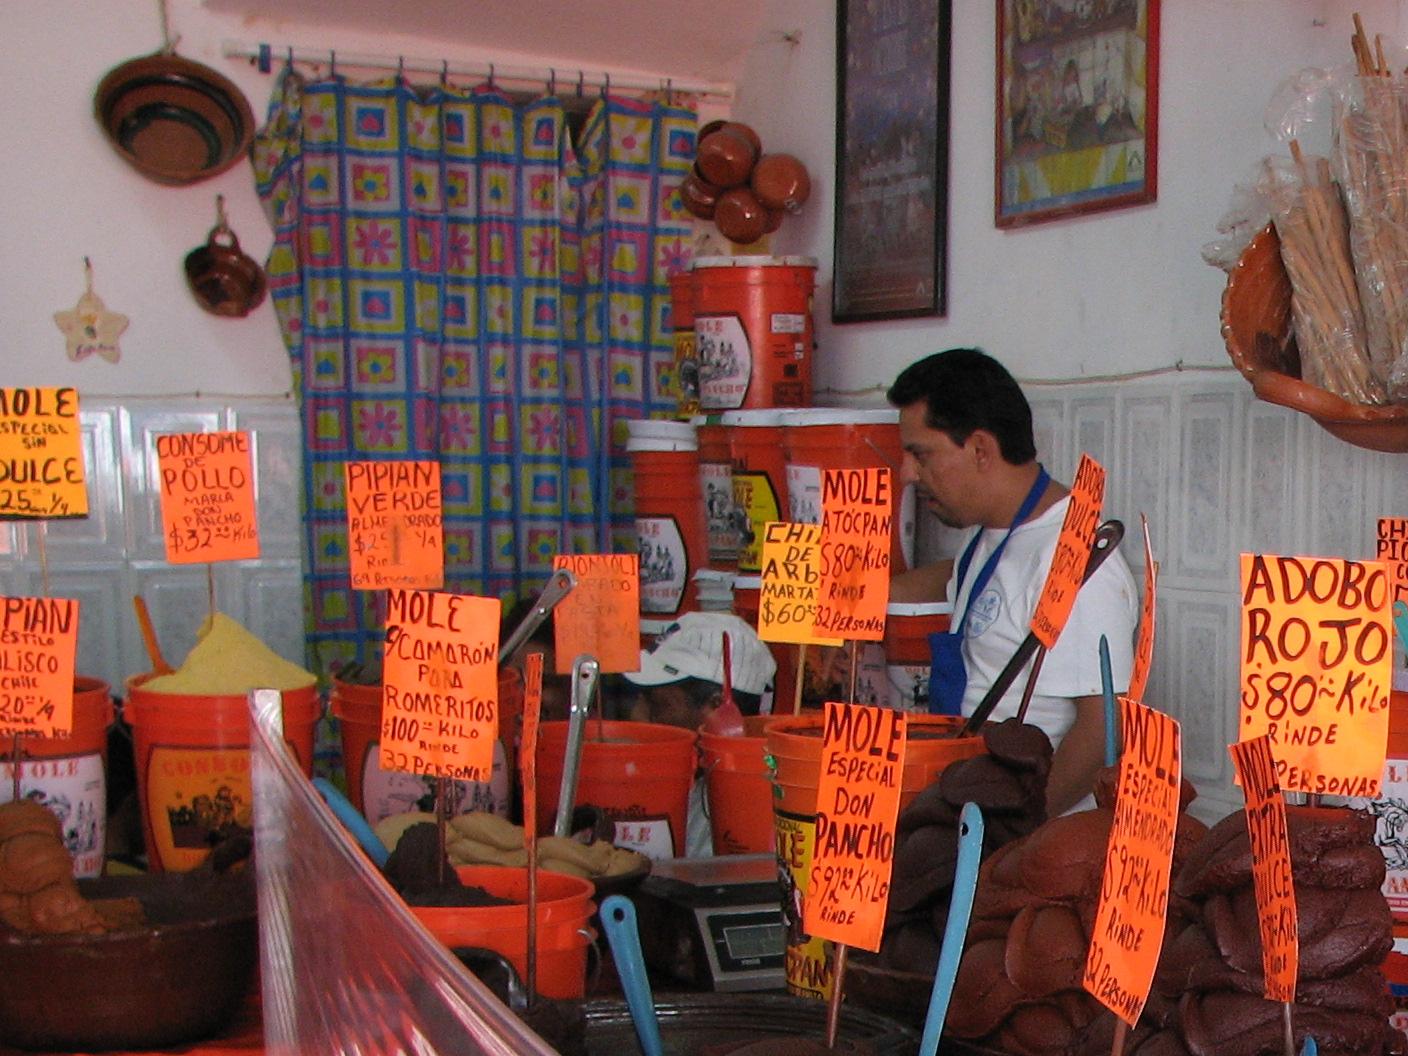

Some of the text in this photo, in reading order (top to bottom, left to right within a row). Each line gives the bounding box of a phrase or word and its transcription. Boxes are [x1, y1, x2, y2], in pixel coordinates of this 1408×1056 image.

[0, 421, 68, 435] SPECiAL
[157, 432, 248, 459] CONSOME
[184, 456, 206, 468] DE
[348, 461, 433, 493] PIPIAN
[163, 466, 245, 495] POLLO
[823, 469, 889, 506] MOLE
[352, 489, 441, 514] VERDE
[786, 546, 814, 562] DE
[1244, 554, 1388, 612] ADOBO
[387, 588, 464, 633] MOLE
[1246, 607, 1388, 670] ROJO
[0, 650, 58, 673] LiSCO
[418, 664, 464, 689] PARA
[385, 685, 495, 723] ROMERITOS
[438, 720, 479, 738] KILO
[824, 704, 904, 762] MOLE
[1124, 700, 1178, 787] MOLE
[834, 787, 873, 819] DON
[814, 811, 892, 863] PANCHO
